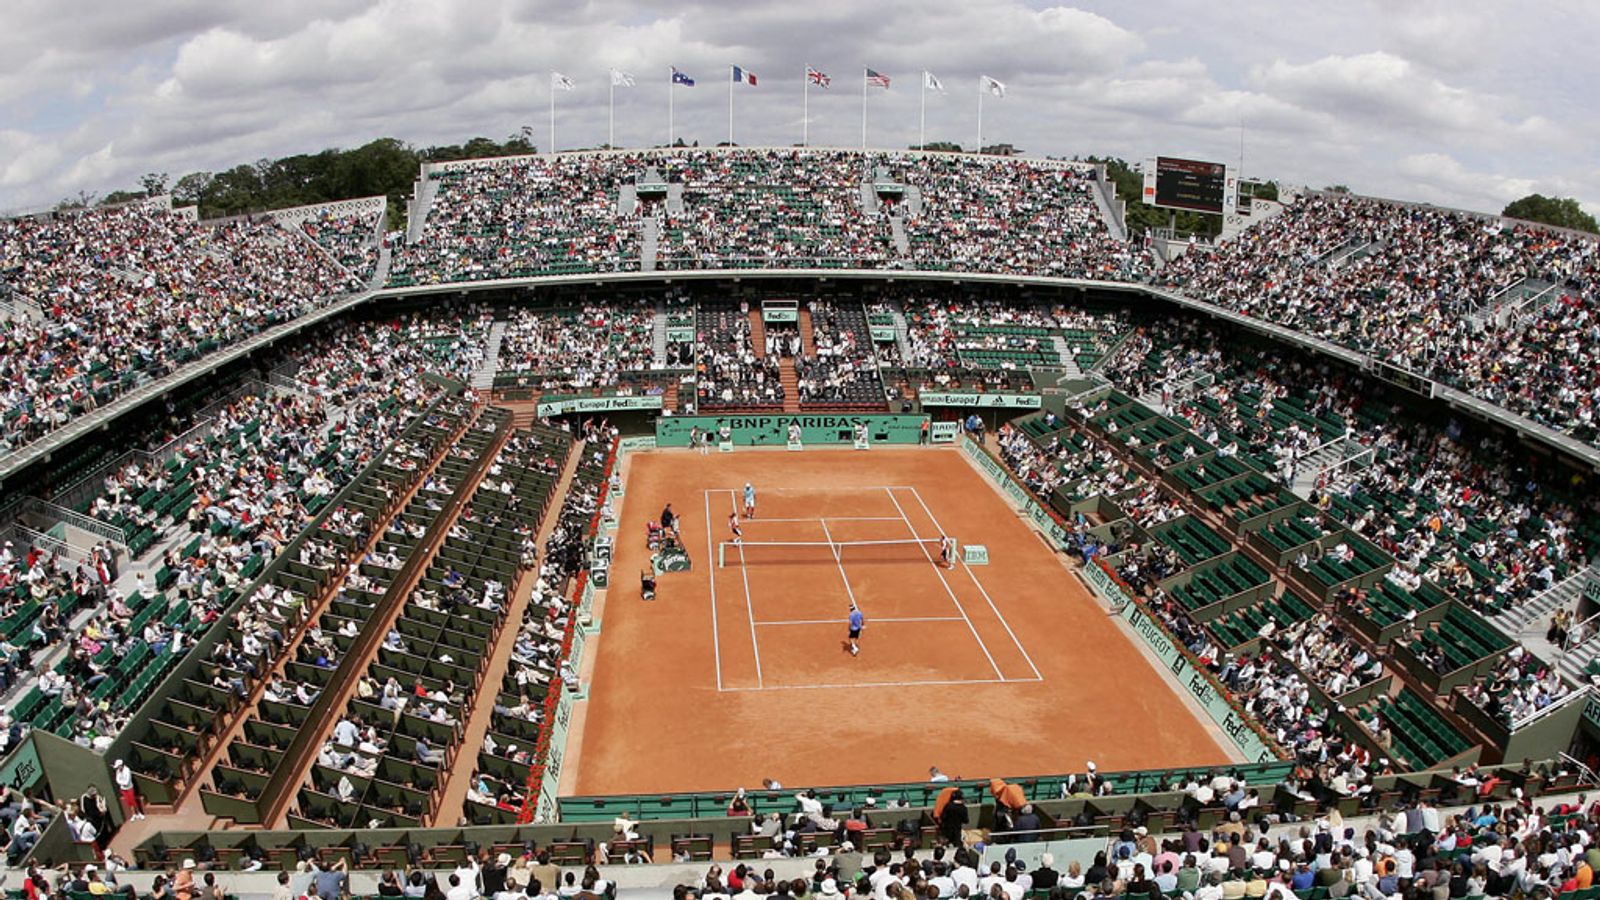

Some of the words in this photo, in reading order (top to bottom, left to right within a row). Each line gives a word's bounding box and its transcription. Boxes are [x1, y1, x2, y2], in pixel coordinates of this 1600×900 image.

[730, 418, 771, 429] BNP
[777, 416, 862, 428] PARIBAS
[1138, 619, 1171, 656] PEUGEOT
[1189, 674, 1214, 707] FedEx
[1222, 712, 1249, 749] FedEx
